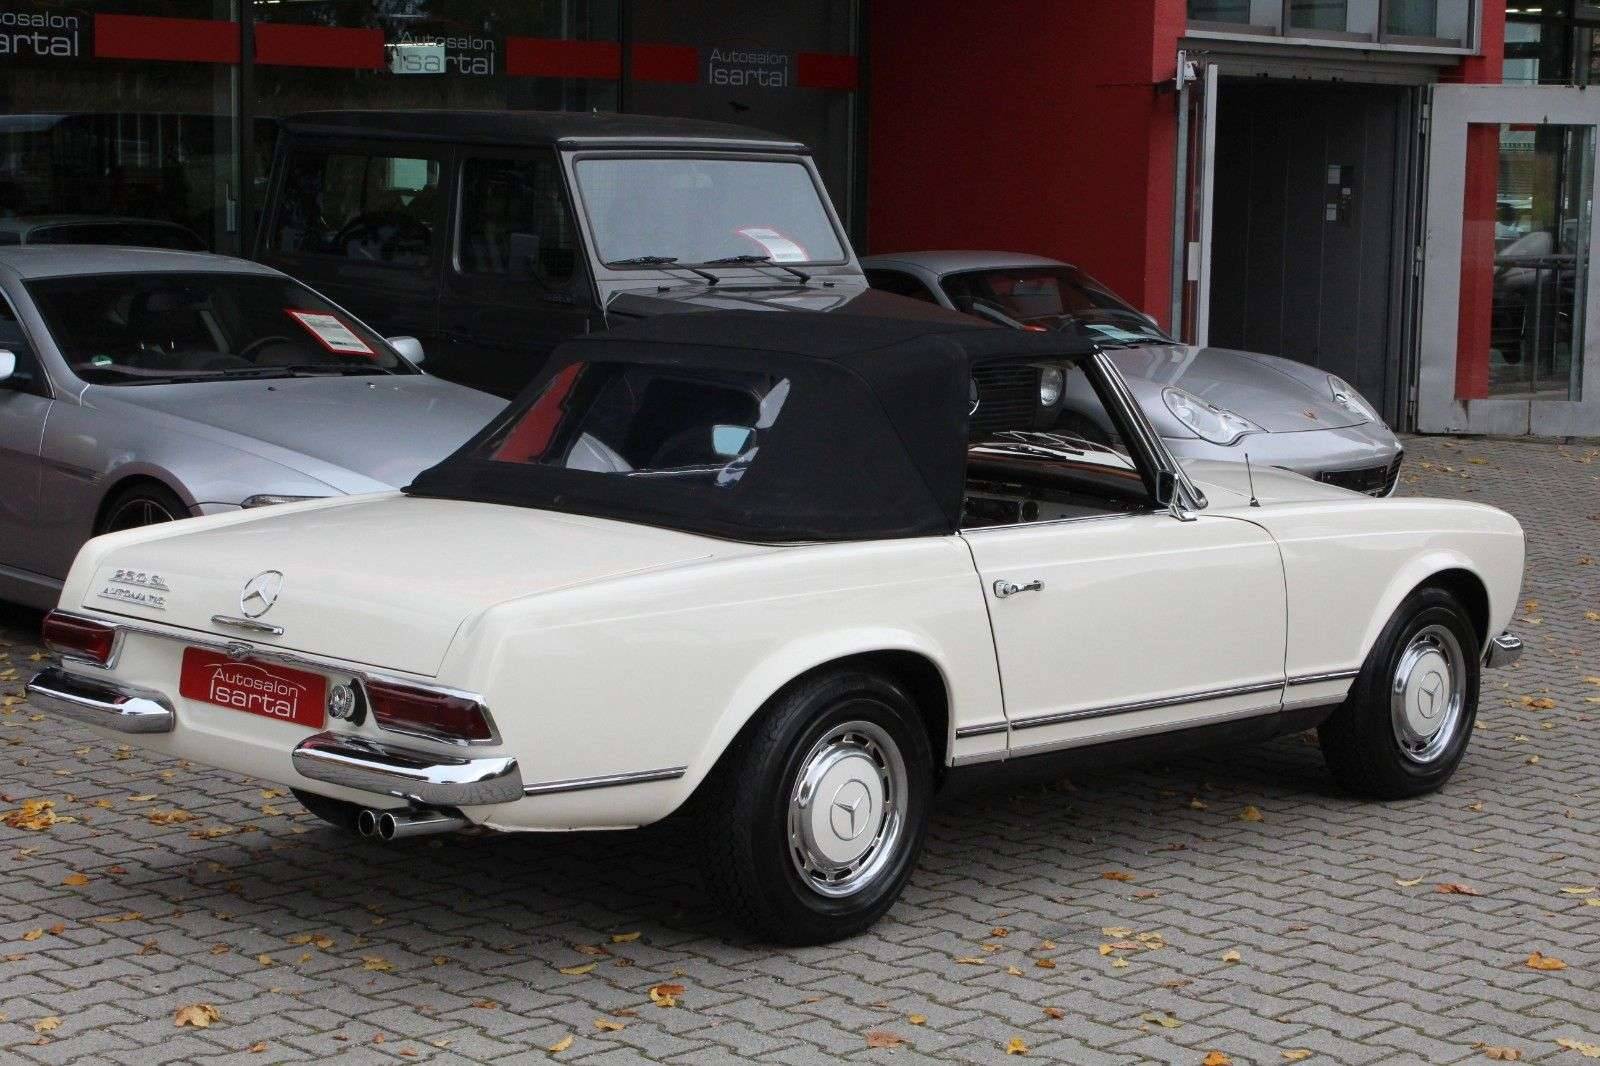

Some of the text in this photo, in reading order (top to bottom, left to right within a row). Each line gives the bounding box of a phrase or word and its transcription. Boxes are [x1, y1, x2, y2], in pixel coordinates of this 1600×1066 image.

[0, 11, 79, 28] osalon
[710, 48, 788, 64] Autosalon
[709, 62, 788, 87] Isartal
[212, 667, 299, 698] Autosalon
[209, 679, 298, 719] Isartal
